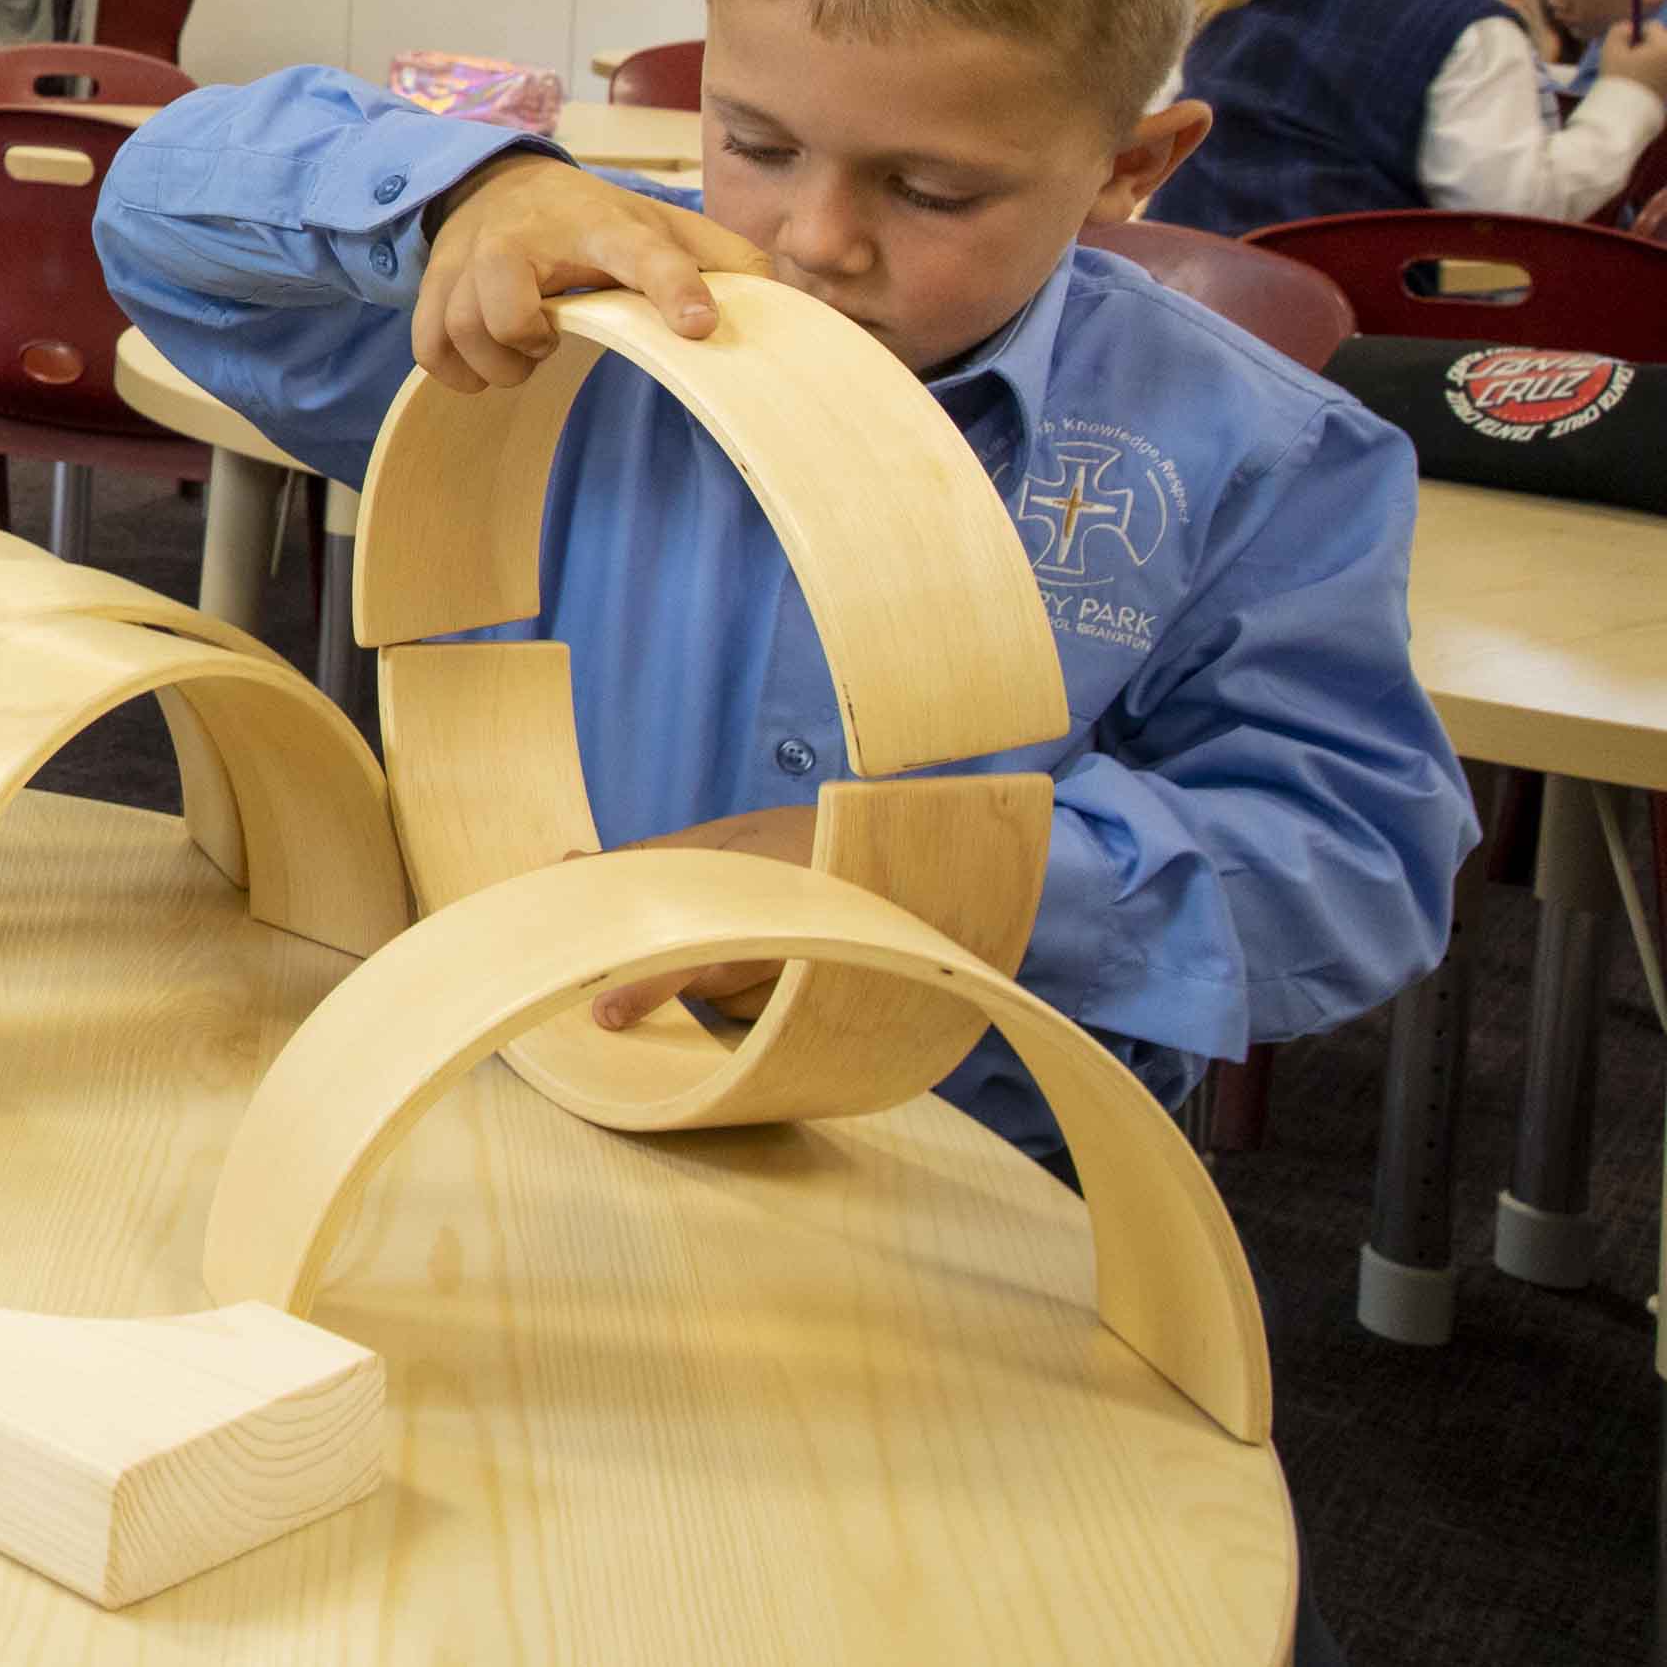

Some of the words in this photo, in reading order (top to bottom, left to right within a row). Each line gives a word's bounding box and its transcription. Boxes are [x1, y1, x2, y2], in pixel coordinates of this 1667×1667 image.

[1475, 370, 1592, 409] CRUZ
[1473, 416, 1546, 442] SANTA
[1547, 403, 1602, 439] CRUZ
[1078, 597, 1158, 638] PARK
